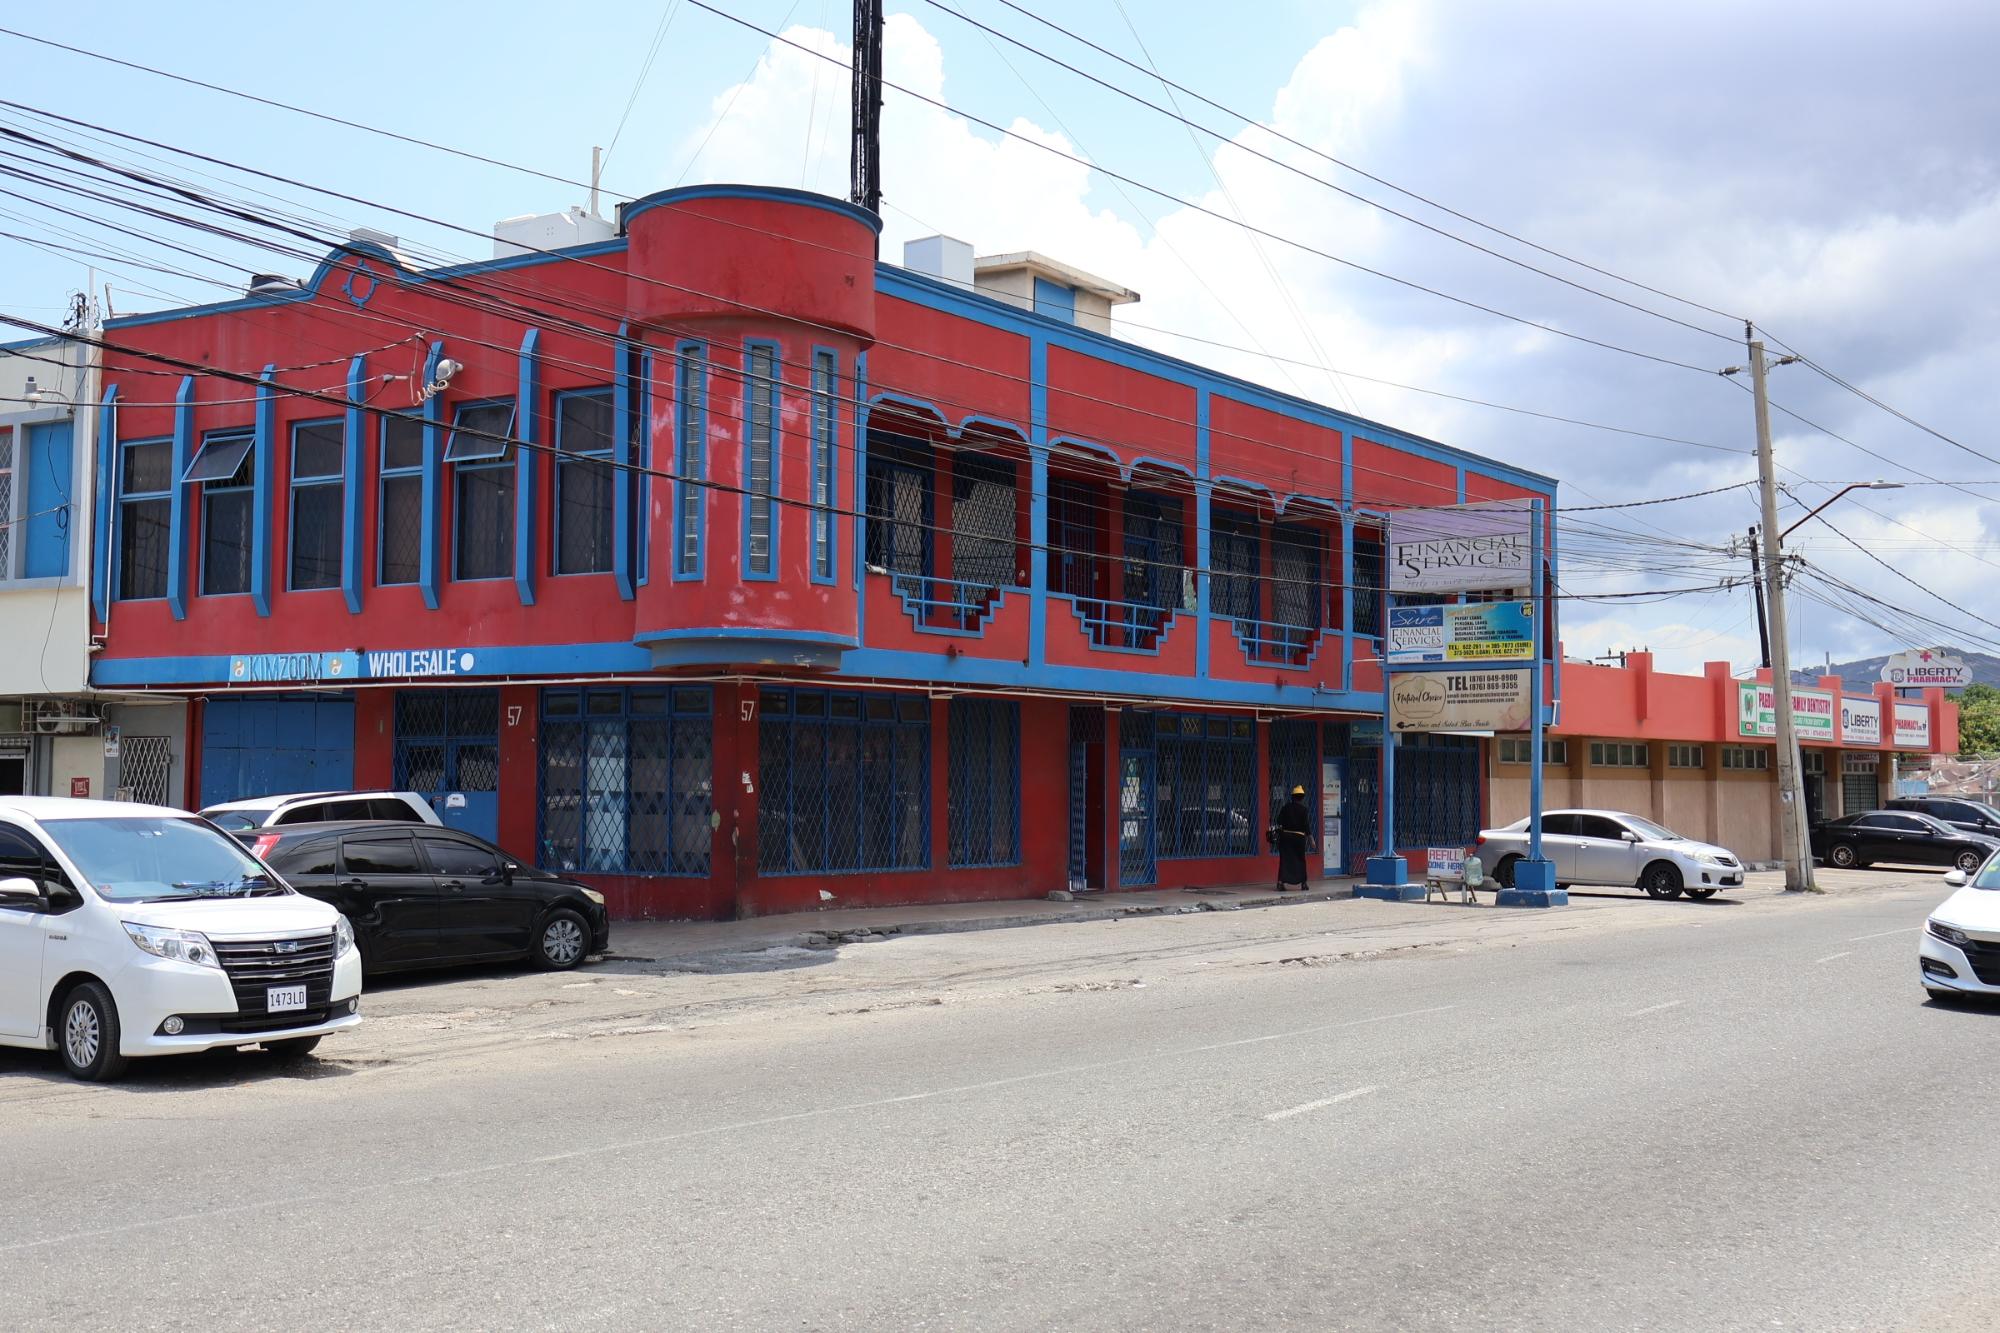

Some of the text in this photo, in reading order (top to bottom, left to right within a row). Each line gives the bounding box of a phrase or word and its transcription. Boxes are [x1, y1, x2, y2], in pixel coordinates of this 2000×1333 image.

[1397, 536, 1518, 566] FINANCIAL
[1404, 551, 1521, 579] SERVICES
[1392, 609, 1441, 626] Sure
[1392, 628, 1441, 642] FINANCIAL
[1395, 635, 1442, 651] SERVICES
[250, 649, 456, 682] KIMZOOM WHOLESALE
[1907, 667, 1963, 677] LIBERTY
[1446, 676, 1468, 691] TEL
[1397, 691, 1422, 704] Natural
[741, 700, 755, 721] 57
[1807, 698, 1831, 715] DENTISTRY
[508, 706, 522, 726] 57
[1850, 713, 1879, 728] LIBERTY
[1429, 849, 1459, 861] REFILL
[1447, 862, 1464, 870] HERE
